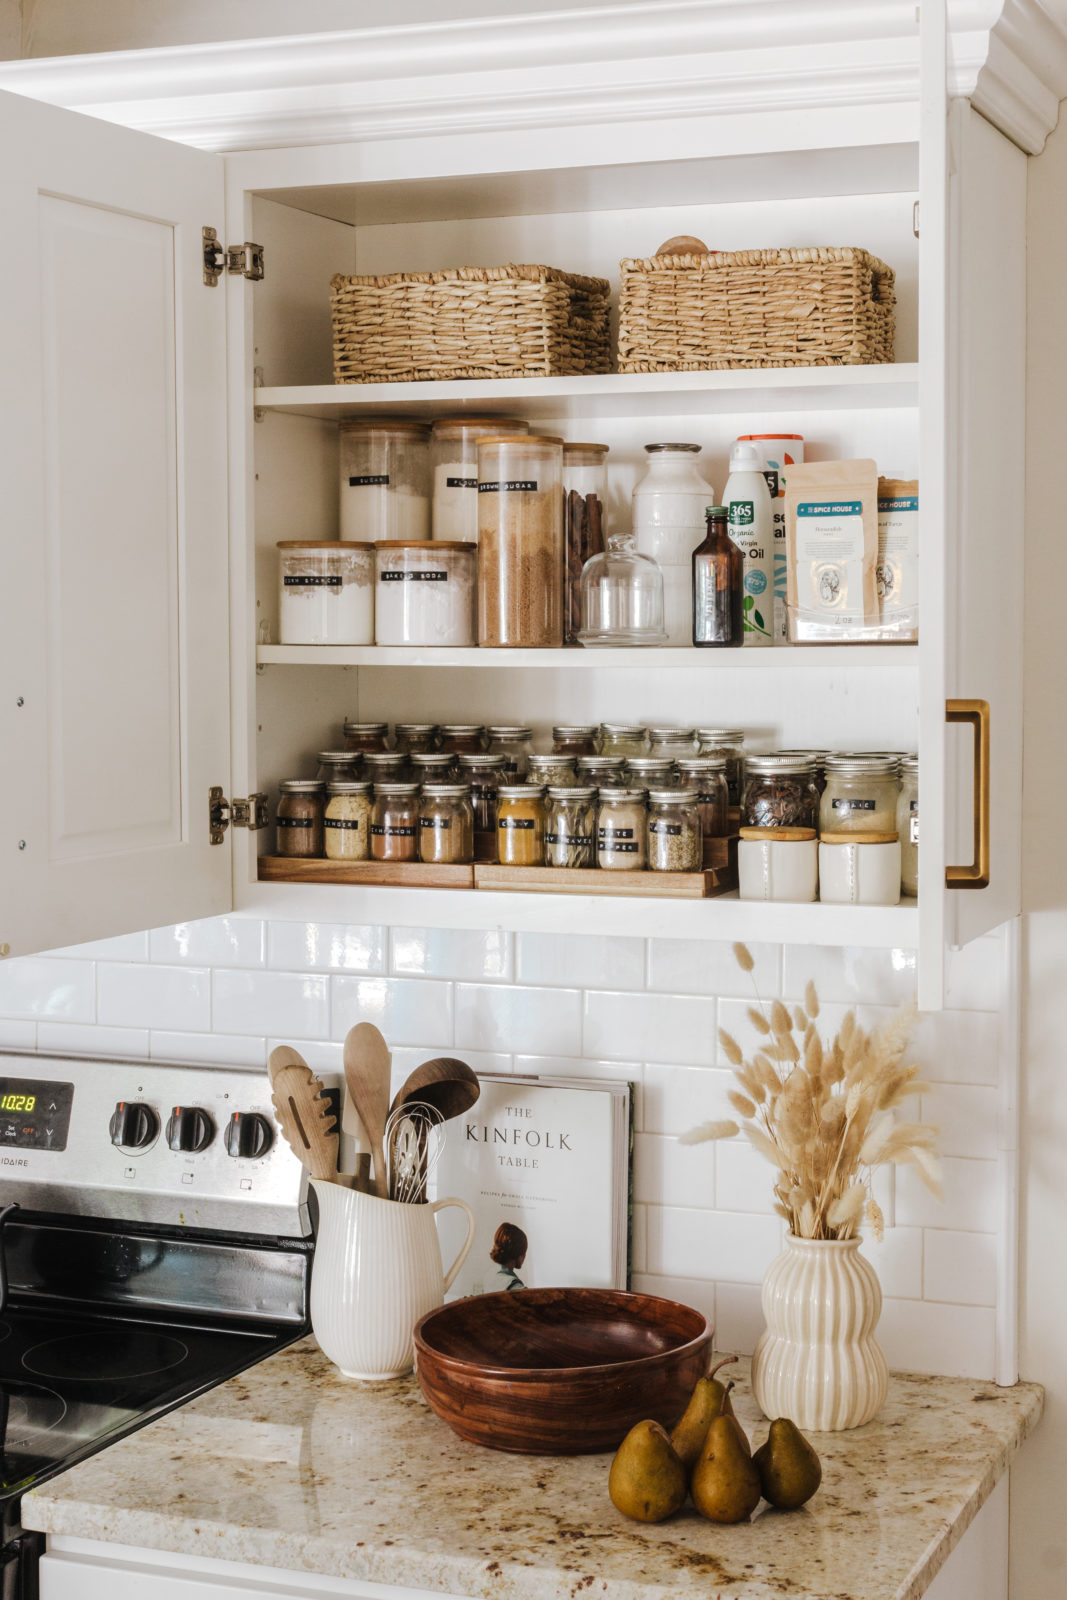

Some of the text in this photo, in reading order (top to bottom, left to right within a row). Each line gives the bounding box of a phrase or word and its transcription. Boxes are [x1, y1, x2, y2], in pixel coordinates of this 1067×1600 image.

[730, 504, 752, 517] 365
[749, 548, 764, 559] Oil
[599, 842, 633, 851] PPER
[504, 1106, 533, 1119] THE
[466, 1124, 572, 1151] KINFOLK
[498, 1155, 539, 1169] TABLE
